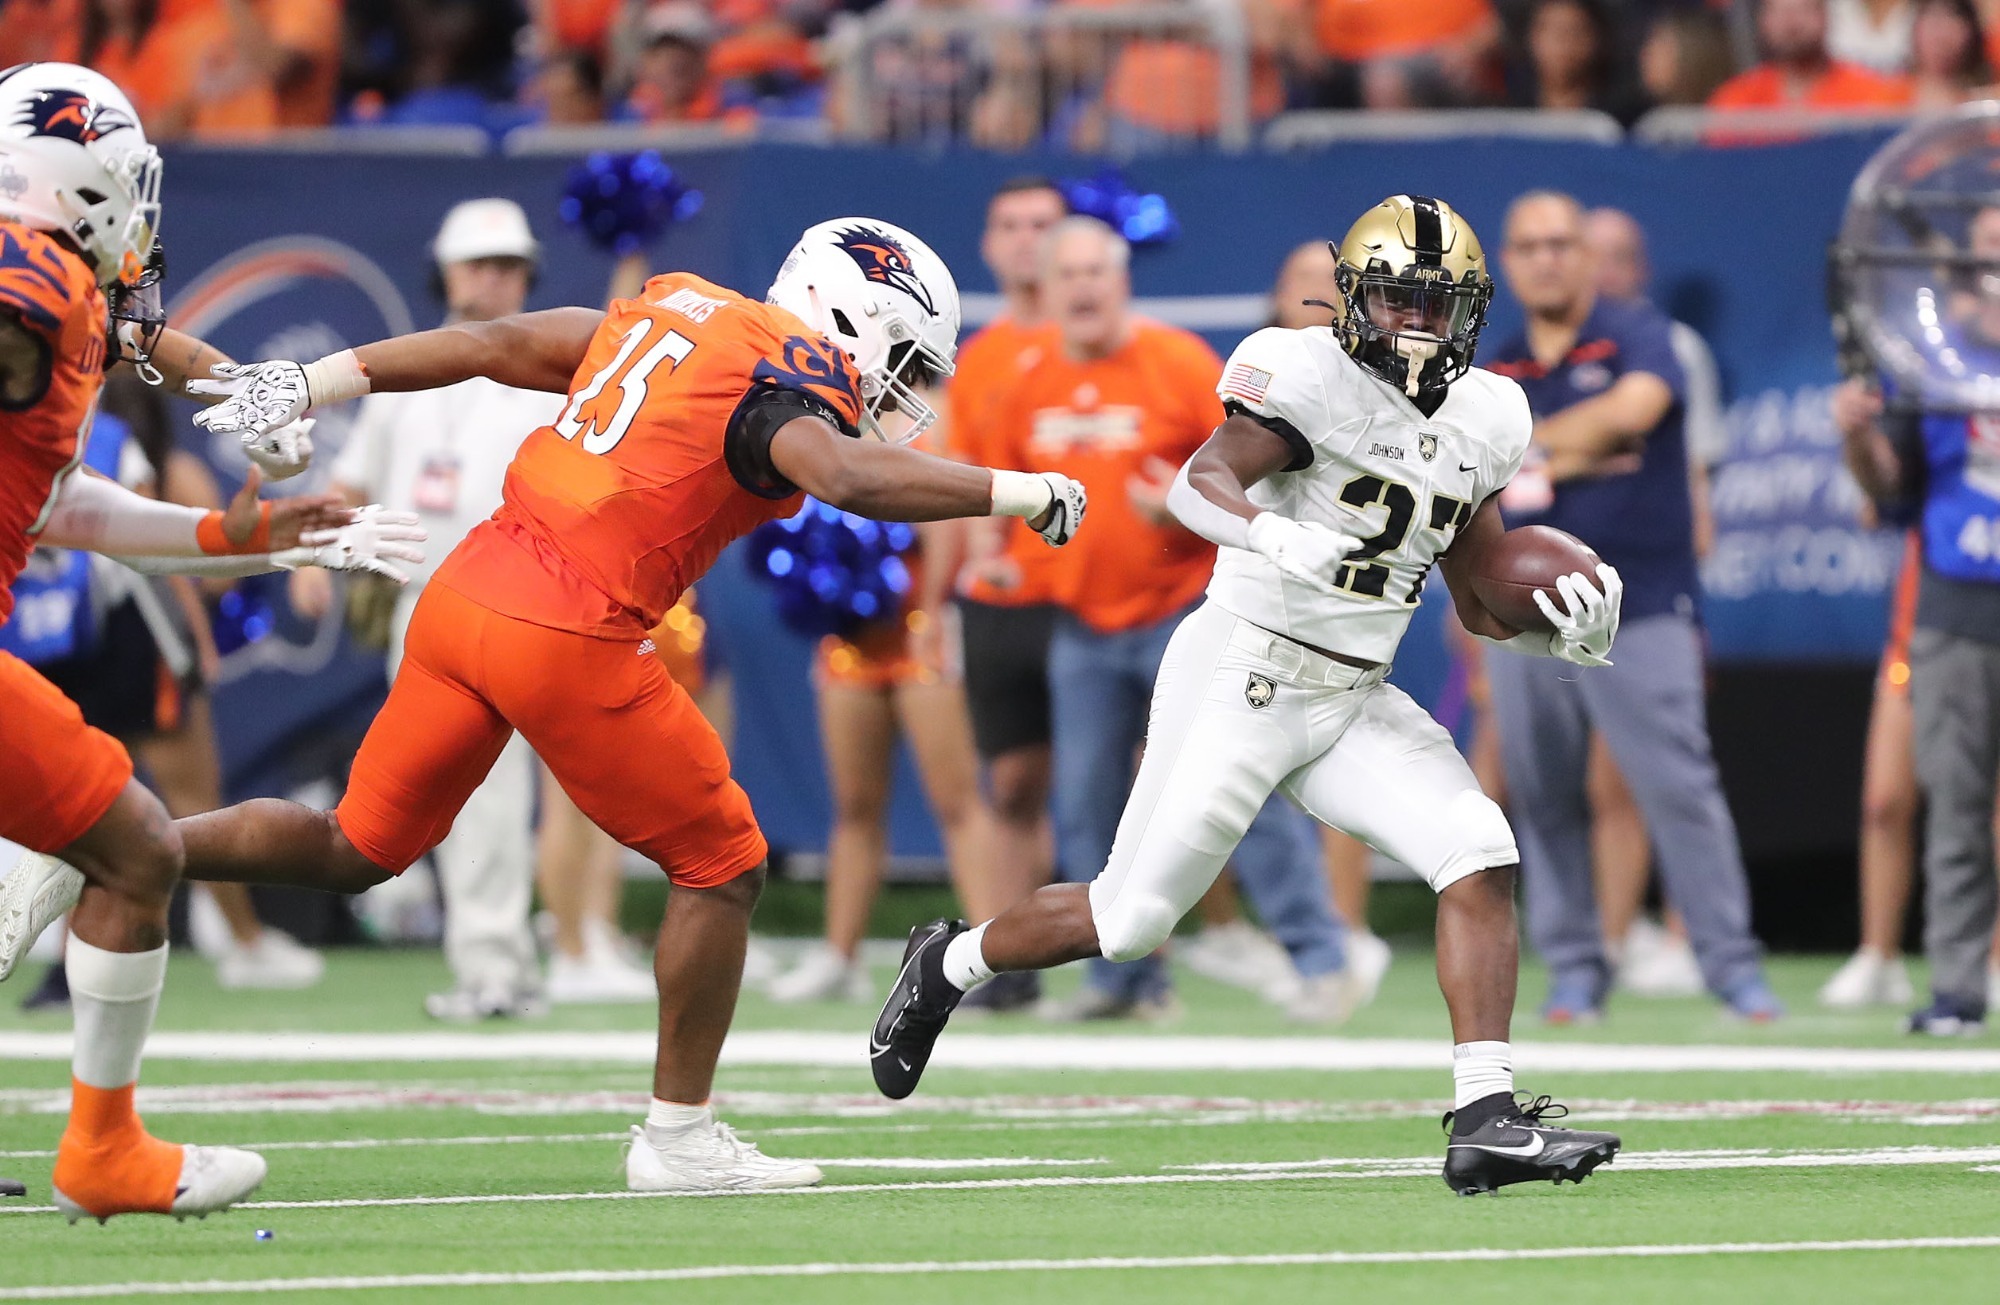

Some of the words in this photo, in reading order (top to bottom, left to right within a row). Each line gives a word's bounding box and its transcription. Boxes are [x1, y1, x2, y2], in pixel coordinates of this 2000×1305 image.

[1414, 267, 1443, 282] ARMY
[553, 317, 697, 456] 25
[1368, 442, 1405, 461] JOHNSON
[1334, 471, 1473, 610] 27
